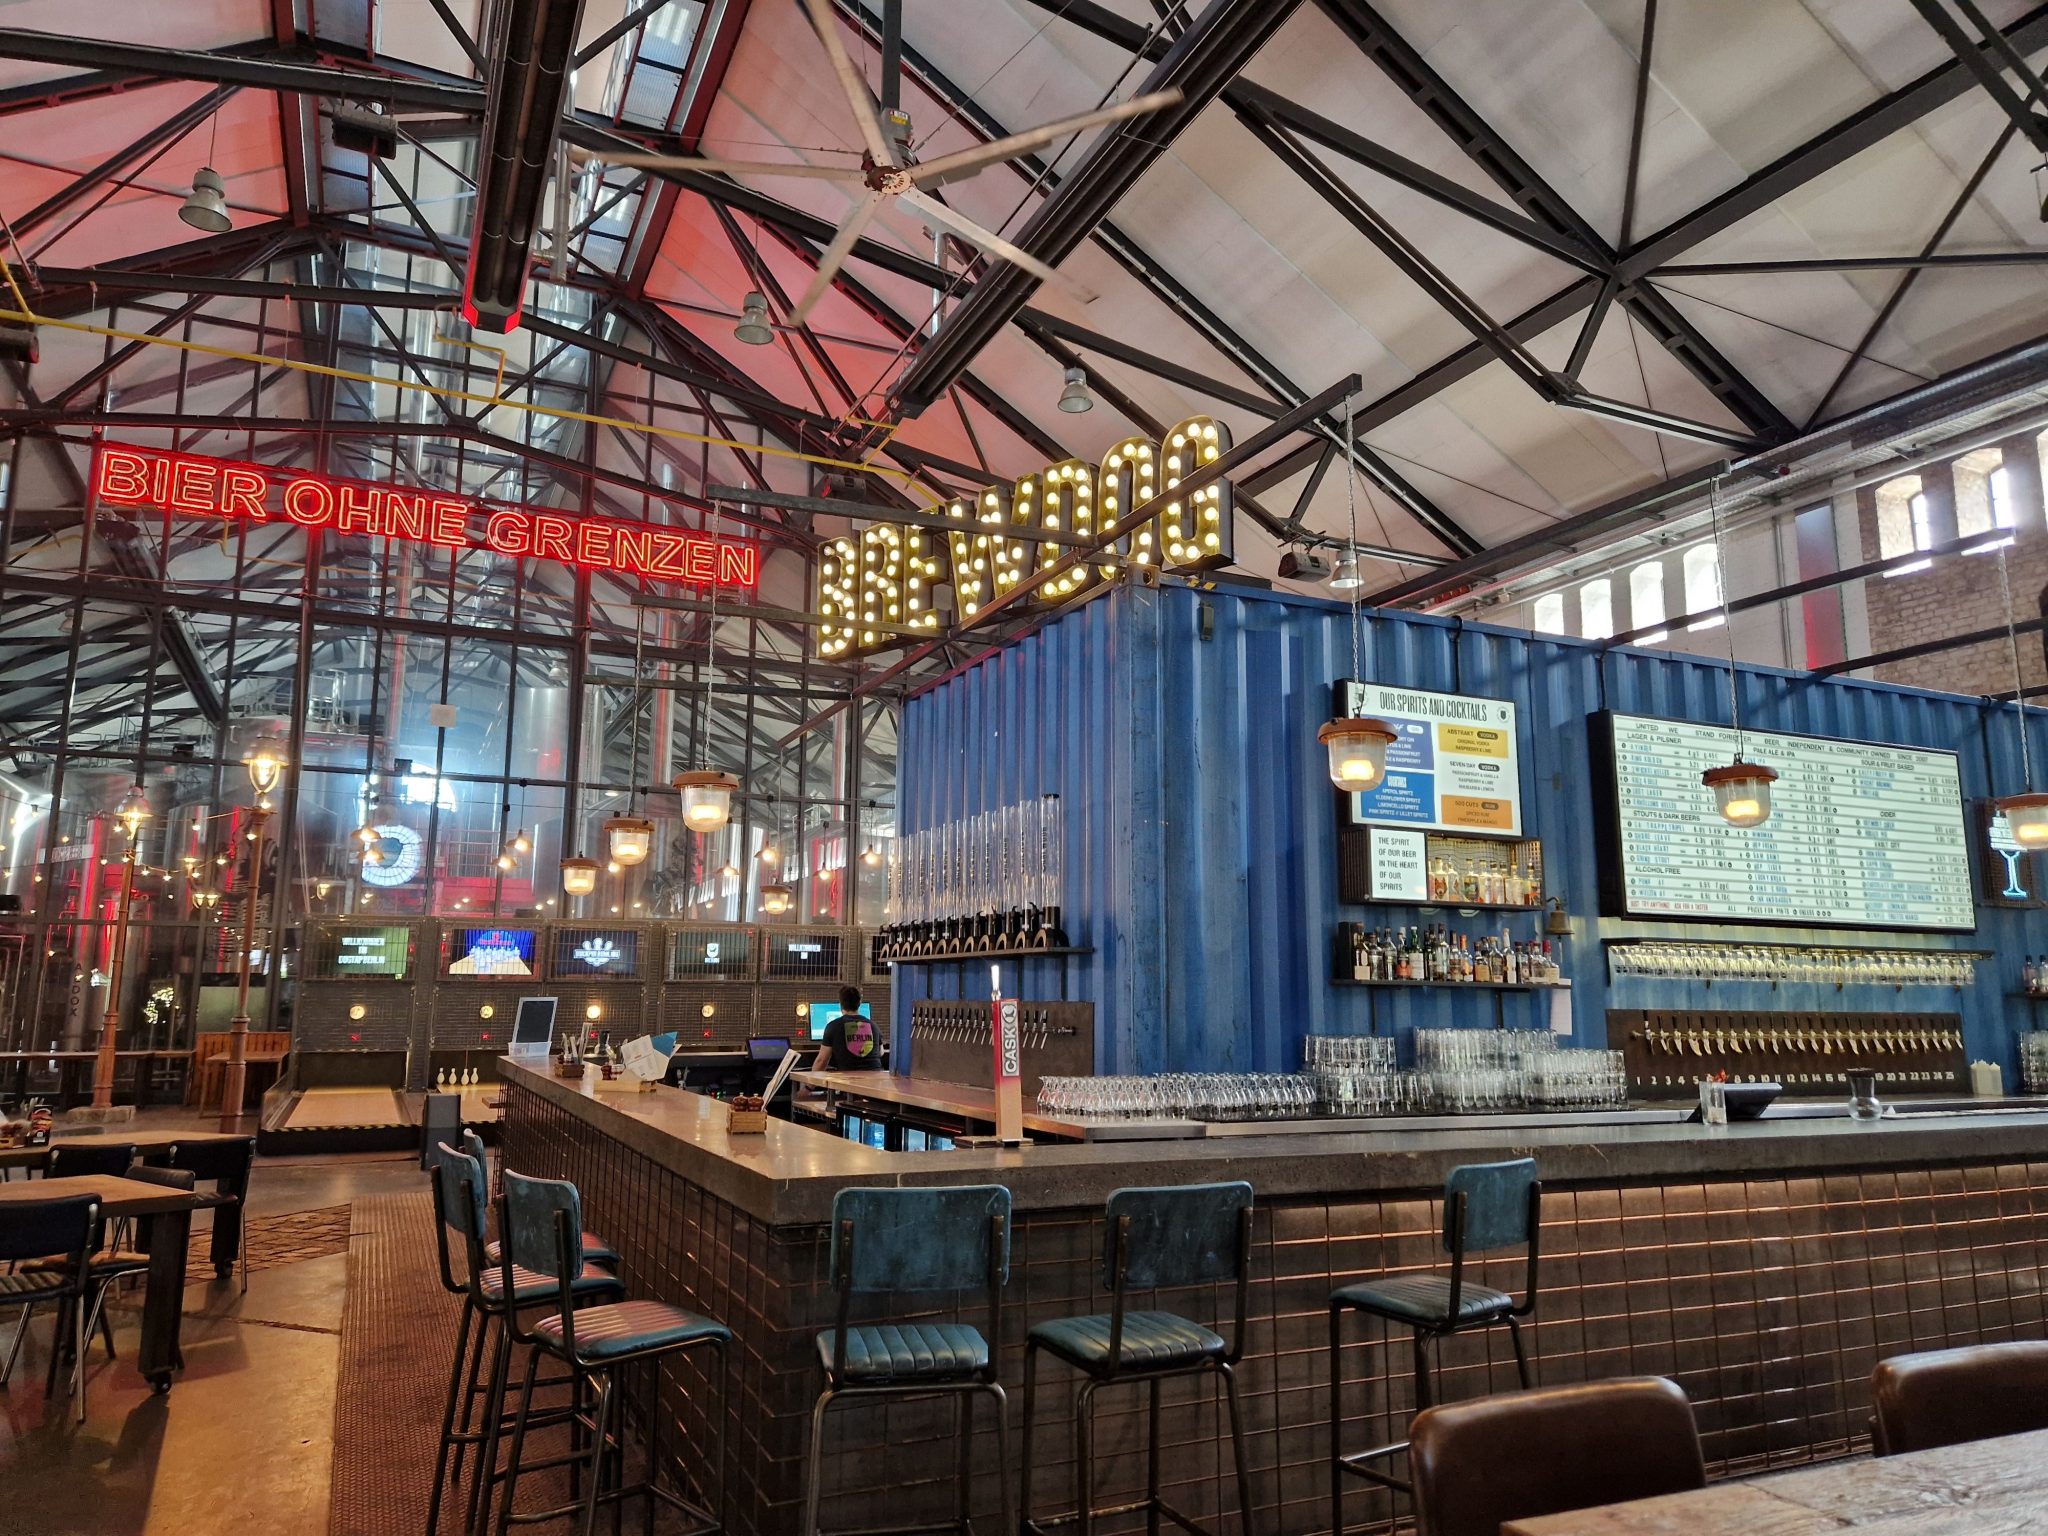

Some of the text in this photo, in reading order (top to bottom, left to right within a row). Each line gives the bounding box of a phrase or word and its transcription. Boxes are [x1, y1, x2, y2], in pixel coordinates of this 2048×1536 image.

[98, 448, 755, 586] BIER OHNE GRENZEN
[817, 414, 1232, 660] BREWDOG
[1380, 692, 1487, 722] OUR SPIRITS AND COCKTAILS
[1787, 742, 1825, 751] INDEPENDENT
[1837, 747, 1868, 756] COMMUNITY
[1378, 837, 1389, 845] THE
[1400, 861, 1418, 869] HEART
[1635, 866, 1664, 874] ALCOHOL
[1380, 883, 1402, 891] SPIRITS
[1004, 1028, 1018, 1074] CASK
[1651, 1076, 1657, 1085] 2
[1665, 1076, 1671, 1085] 3
[1678, 1076, 1685, 1085] 4
[1693, 1076, 1699, 1085] 5
[1734, 1075, 1741, 1083] 8
[1748, 1074, 1755, 1083] 9
[1761, 1074, 1769, 1083] 10
[1787, 1074, 1796, 1082] 12
[1800, 1074, 1808, 1082] 13
[1812, 1074, 1821, 1082] 14
[1825, 1073, 1833, 1082] 15
[1838, 1073, 1846, 1082] 16
[1875, 1072, 1883, 1081] 19
[1887, 1072, 1896, 1081] 20
[1910, 1072, 1919, 1080] 22
[1921, 1072, 1930, 1080] 23
[1945, 1072, 1954, 1080] 25
